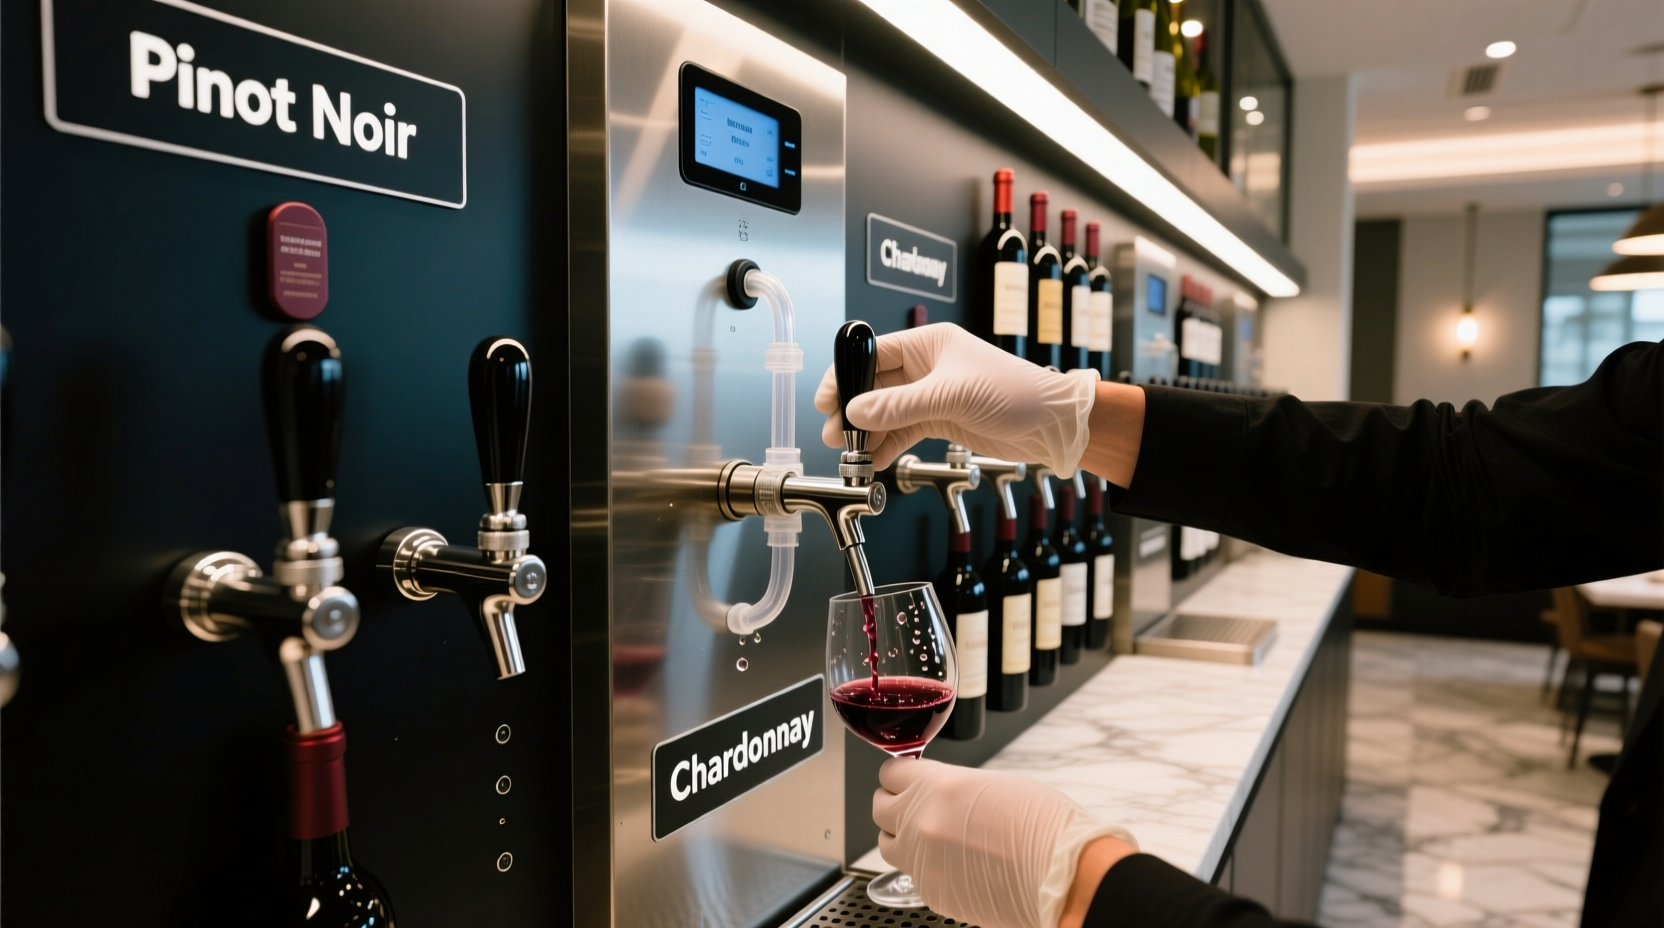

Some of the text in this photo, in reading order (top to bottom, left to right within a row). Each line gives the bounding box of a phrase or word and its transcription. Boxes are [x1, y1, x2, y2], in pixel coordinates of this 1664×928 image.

[130, 31, 417, 160] Pinot Noir
[670, 710, 815, 802] Chardonnay
